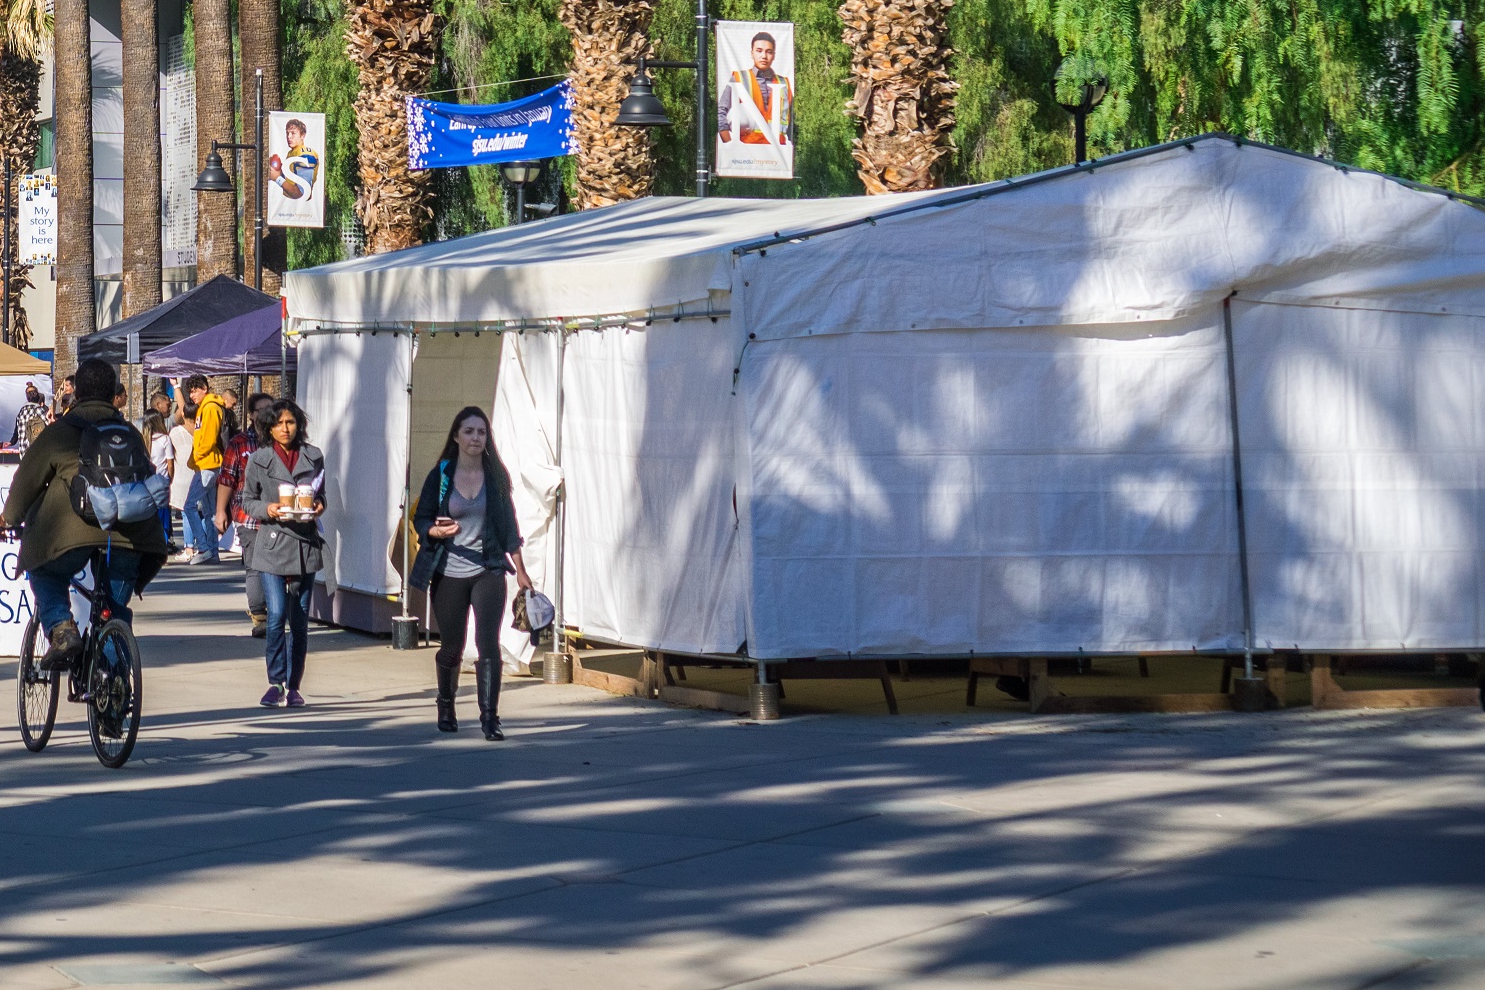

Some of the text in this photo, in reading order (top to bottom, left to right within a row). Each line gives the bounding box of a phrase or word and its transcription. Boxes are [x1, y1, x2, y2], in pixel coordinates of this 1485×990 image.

[517, 105, 552, 128] January
[472, 132, 529, 157] sjsu.edu/winter
[34, 206, 50, 217] My
[29, 217, 55, 227] story
[38, 227, 46, 235] is
[31, 235, 54, 244] here
